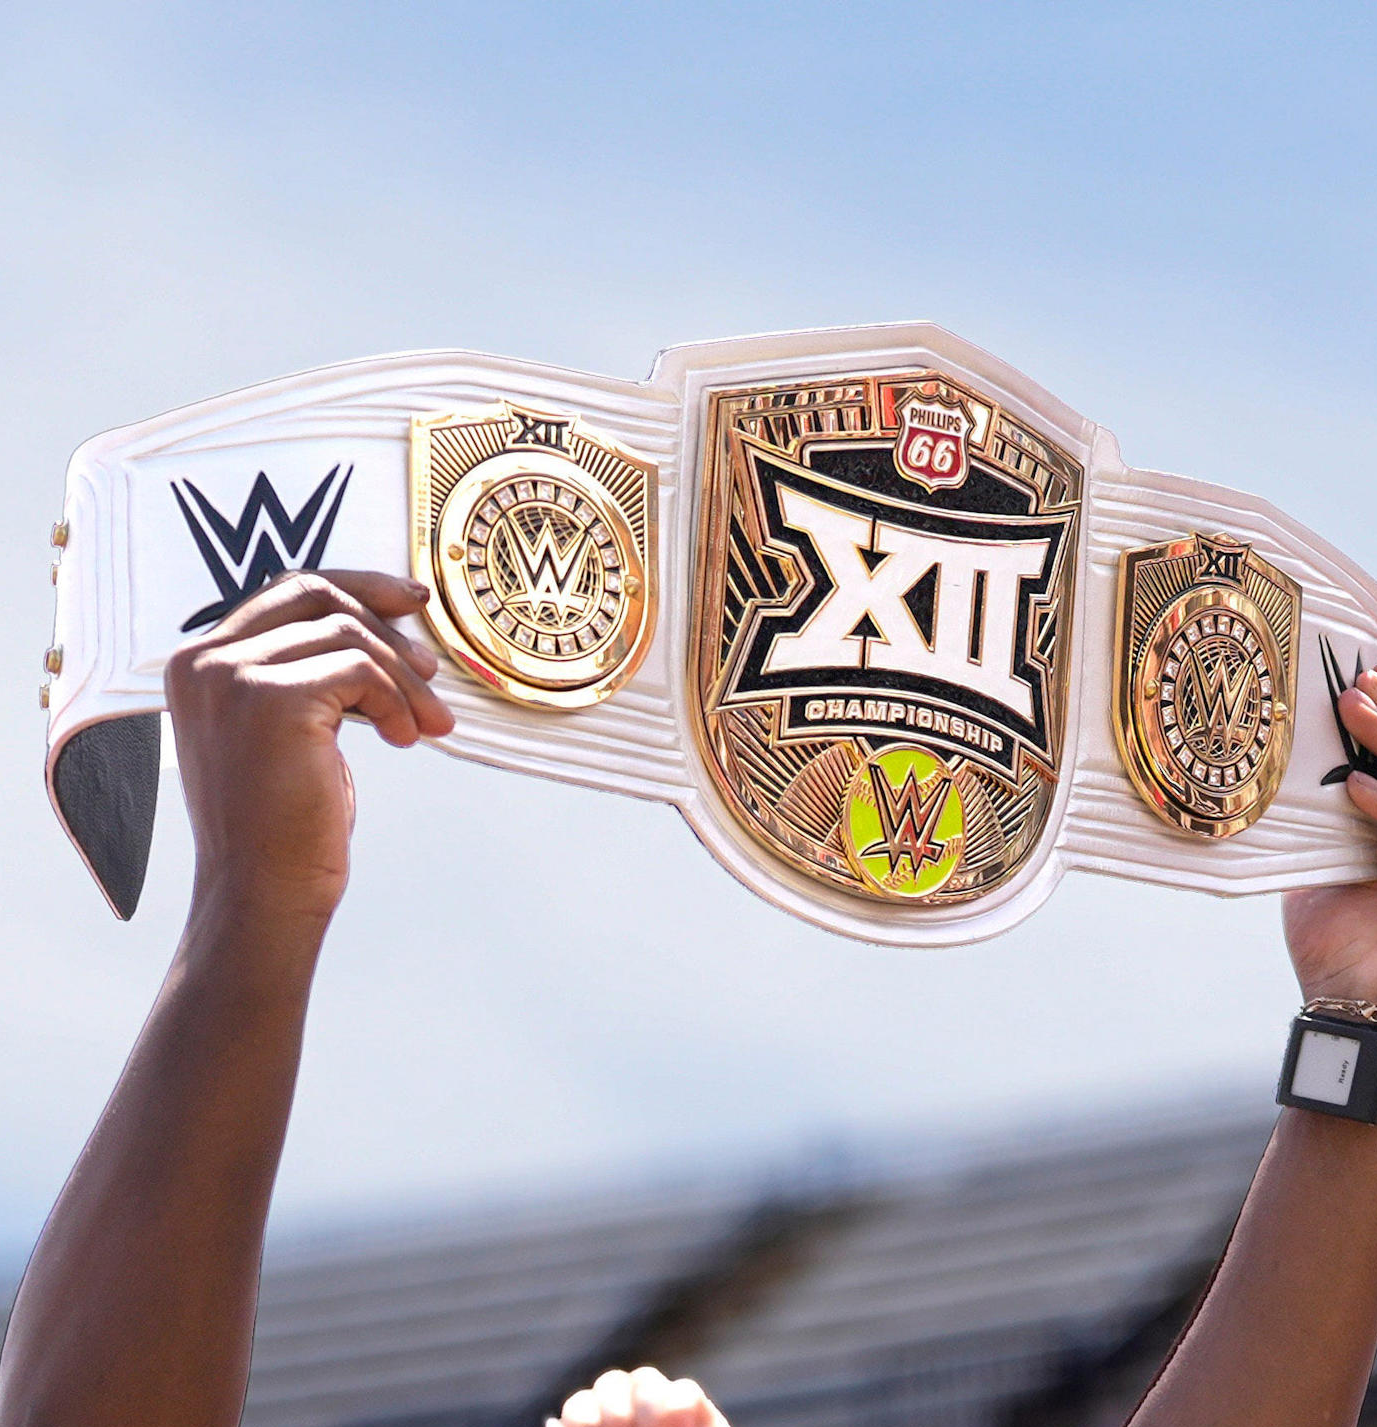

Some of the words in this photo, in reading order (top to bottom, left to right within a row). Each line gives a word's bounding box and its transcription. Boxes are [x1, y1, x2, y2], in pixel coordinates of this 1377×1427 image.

[909, 406, 963, 433] PHILLIPS
[907, 433, 958, 473] 66
[759, 480, 1053, 727] XII
[804, 699, 1004, 753] CHAMPIONSHIP
